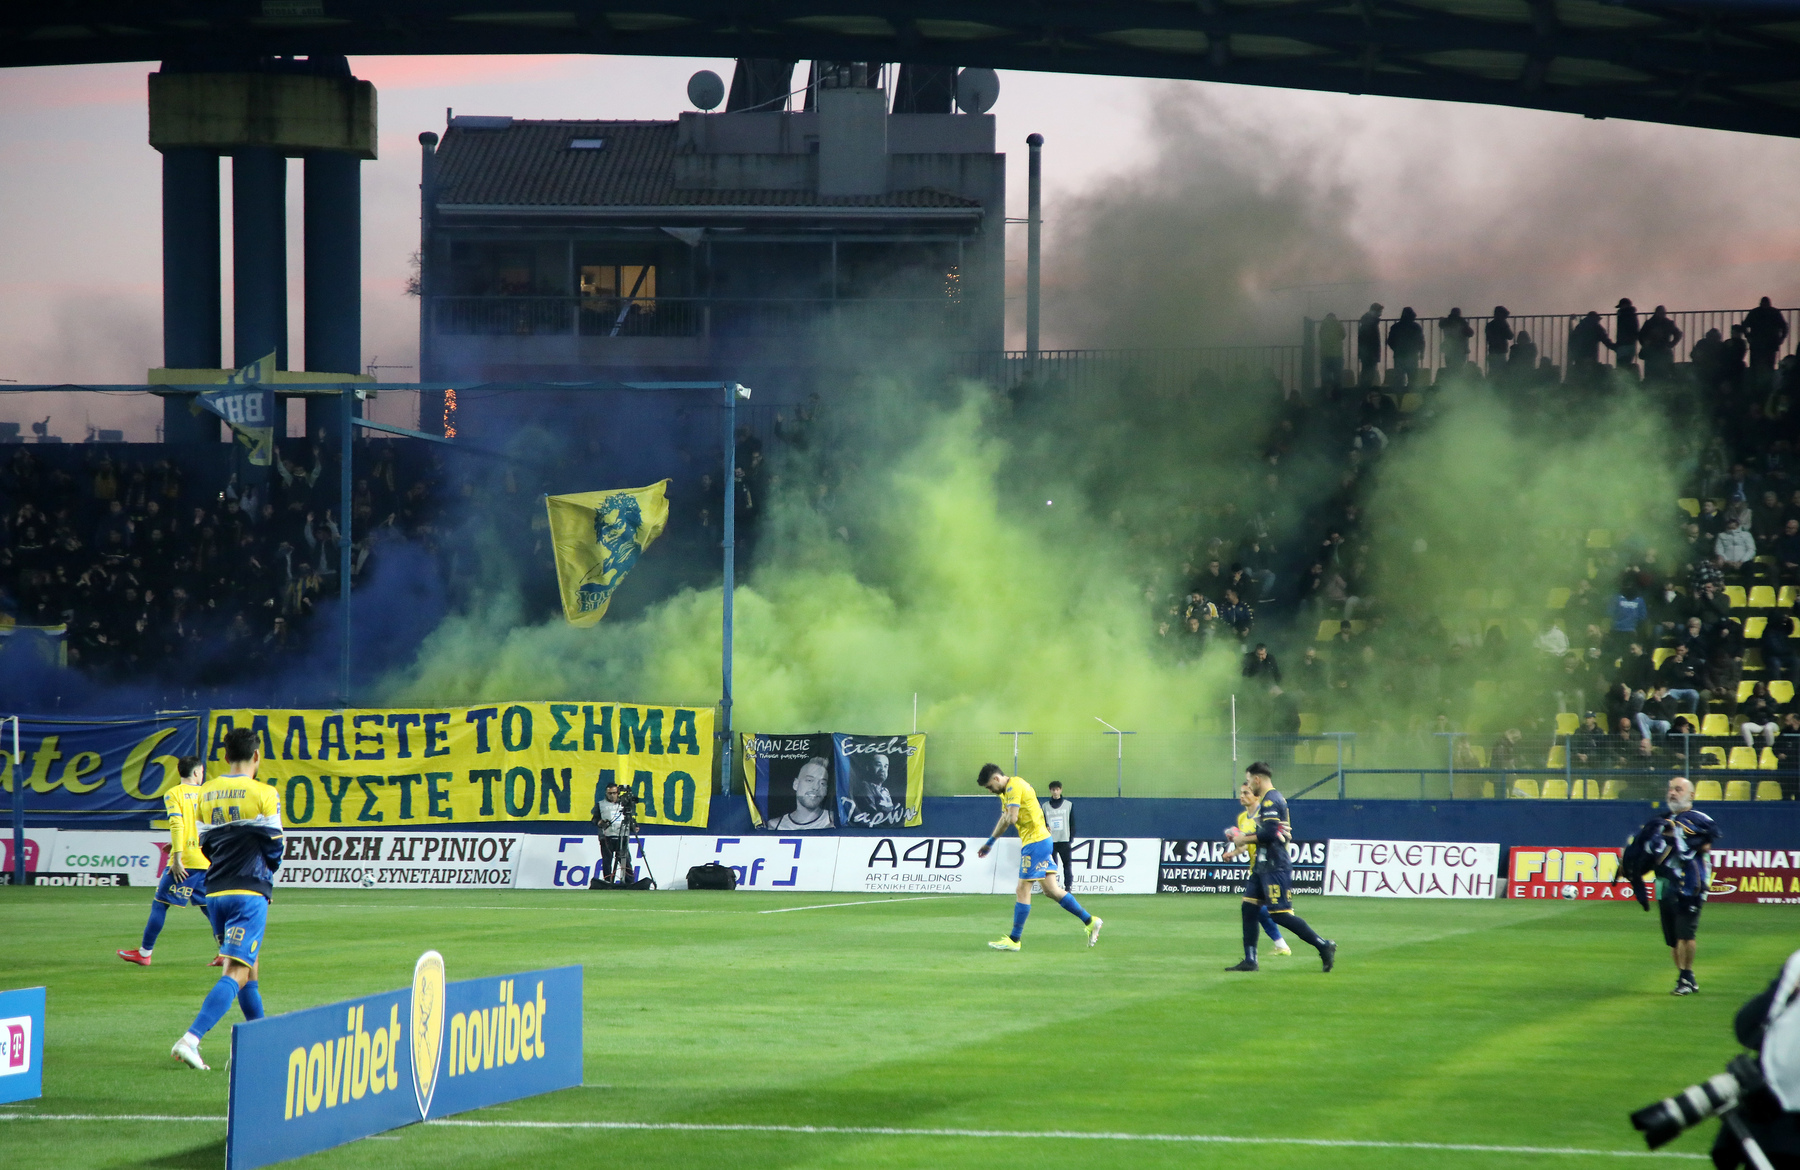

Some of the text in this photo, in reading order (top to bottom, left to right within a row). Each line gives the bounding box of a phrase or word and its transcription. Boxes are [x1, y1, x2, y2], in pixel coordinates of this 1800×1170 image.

[466, 705, 533, 754] ΤΟ
[549, 704, 700, 756] ΣΗΜΑ
[121, 727, 180, 800] 6
[259, 772, 453, 824] ΟΥΣΤΕ
[469, 766, 572, 818] ΤΟΝ
[283, 836, 516, 862] ΕΝΩΣΗ ΑΓΡΙΝΙΟΥ
[867, 838, 967, 869] A4B
[1070, 839, 1129, 869] 4B
[1163, 841, 1182, 862] K.
[65, 854, 150, 868] COSMOTE
[1514, 849, 1656, 883] FiRM
[35, 873, 121, 887] novibet
[376, 867, 512, 884] ΣΥΝΕΤΑΙΡΙΣΜΟΣ
[865, 873, 963, 882] ART 4 BUILDINGS
[1072, 875, 1125, 883] UILDINGS
[1162, 868, 1207, 880] ΥΔΡΕΥΣΗ
[1328, 869, 1494, 897] ΝΤΑΛΙΑΝΗ
[908, 883, 952, 891] ΕΤΑΙΡΕΙΑ
[1162, 884, 1180, 893] Χαρ.
[1218, 885, 1231, 893] 181
[1291, 887, 1322, 895] γρινίου)
[1514, 885, 1654, 900] ΕΠΙΡΑΦΕ
[450, 979, 546, 1077] novibet
[285, 1003, 401, 1121] novibet
